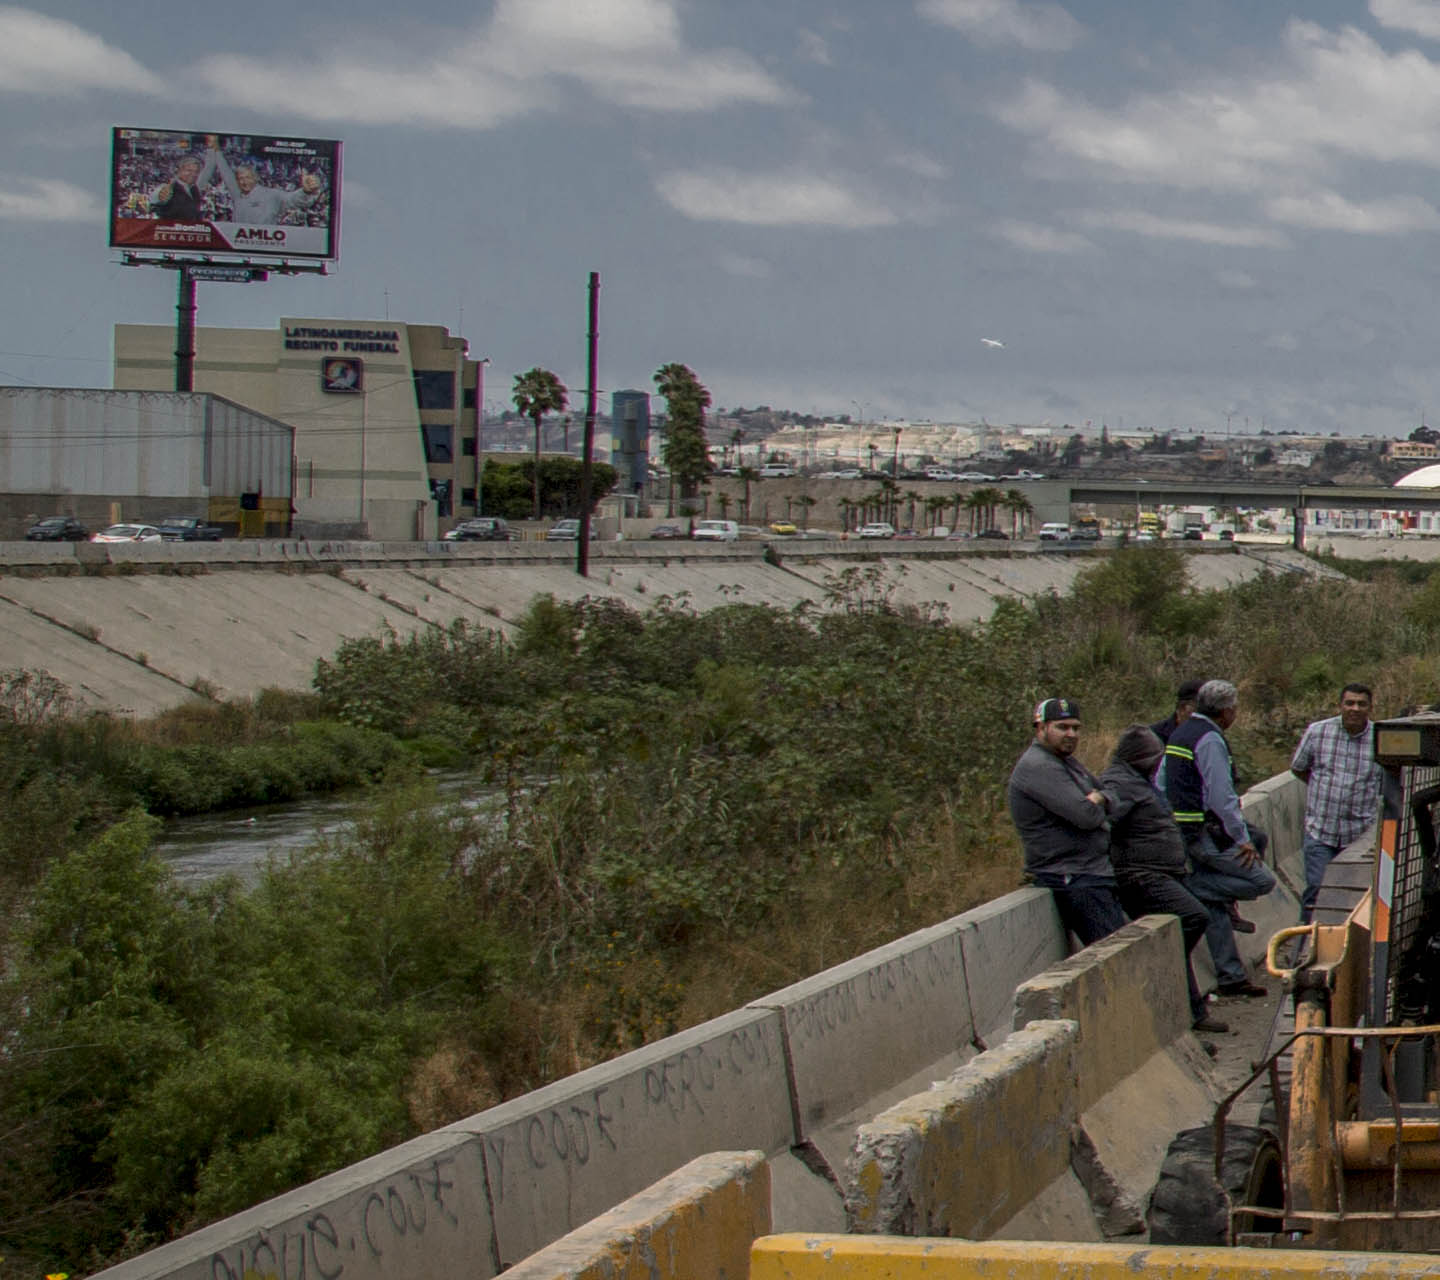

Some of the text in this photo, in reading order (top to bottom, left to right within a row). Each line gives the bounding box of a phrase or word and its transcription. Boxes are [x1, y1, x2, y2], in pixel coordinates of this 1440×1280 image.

[154, 233, 211, 243] SENADOR
[235, 228, 286, 241] AMLO
[285, 327, 399, 340] LATINOAMERICANA
[285, 340, 399, 353] RECINTO FUNERAL
